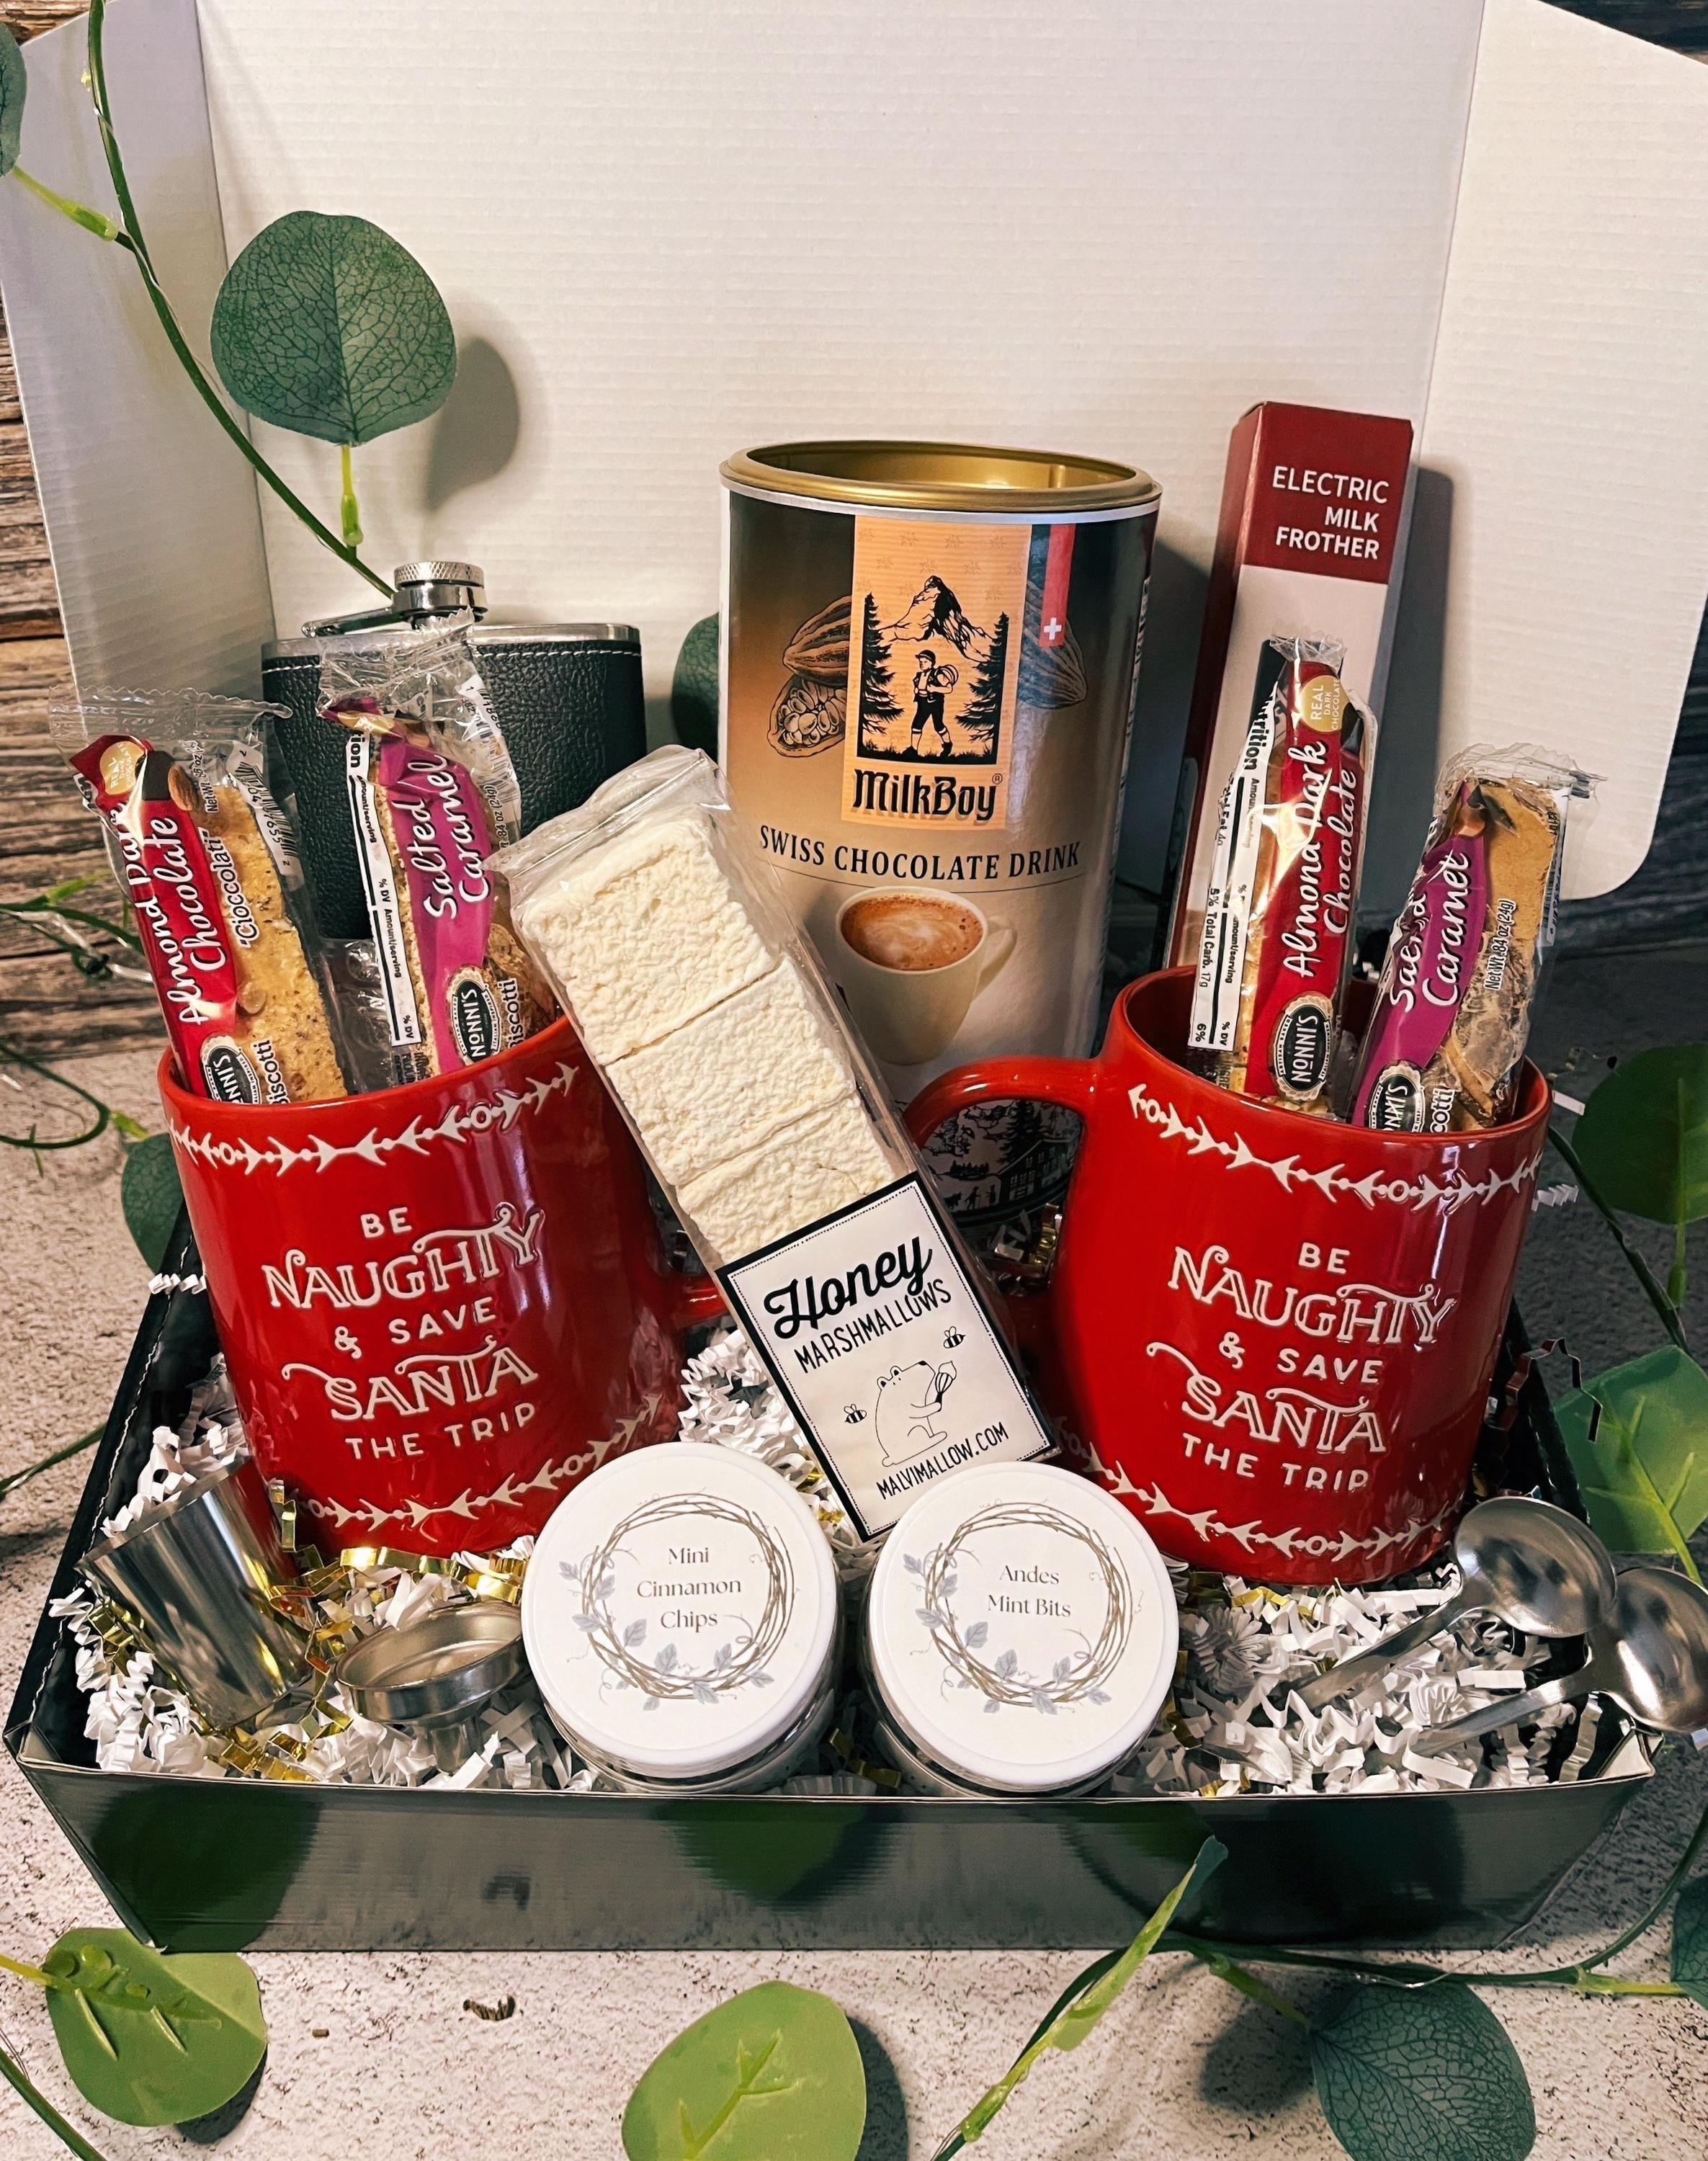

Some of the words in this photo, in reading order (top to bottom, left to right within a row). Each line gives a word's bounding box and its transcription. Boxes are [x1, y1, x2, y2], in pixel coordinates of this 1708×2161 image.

[1272, 465, 1390, 504] ELECTRIC
[1275, 526, 1380, 560] FROTHER
[1324, 506, 1380, 533] MILK
[1310, 685, 1324, 720] REAL
[1331, 677, 1341, 731] CHOCOLATE
[1287, 741, 1326, 828] Dark
[408, 754, 491, 903] Caramel
[759, 825, 826, 867] SWISS
[834, 845, 1000, 880] CHOCOLATE
[1009, 841, 1081, 878] DRINK
[1323, 768, 1356, 935] Chocolate
[391, 796, 459, 919] Salted
[144, 817, 227, 972] Chocolate
[1282, 840, 1323, 978] Almond
[1498, 899, 1516, 926] (24g)
[1205, 911, 1217, 939] Total
[1421, 852, 1470, 1007] Caramel
[1491, 939, 1507, 957] .84
[1497, 924, 1509, 937] oz
[135, 895, 210, 1026] Almond
[385, 908, 402, 978] Amount/serving
[405, 1025, 415, 1039] DV
[1199, 972, 1211, 988] 17g
[1202, 941, 1215, 969] Carb.
[1488, 956, 1505, 974] Wt
[1485, 974, 1501, 990] Net
[461, 988, 487, 1057] NONNI'S
[1195, 1023, 1207, 1042] 6%
[1220, 1032, 1229, 1046] DV
[1291, 1016, 1318, 1083] NONNI'S
[213, 1055, 243, 1104] NNI'S
[1382, 1083, 1408, 1131] NNI'S
[1430, 1088, 1455, 1133] cotti
[361, 1207, 412, 1238] BE
[261, 1206, 543, 1309] NAUGHTY
[1298, 1243, 1350, 1274] BE
[764, 1236, 933, 1339] Honey
[1168, 1245, 1457, 1344] NAUGHTY
[334, 1326, 362, 1359] &
[388, 1297, 496, 1345] SAVE
[794, 1279, 952, 1374] MARSHMALLOWS
[282, 1335, 539, 1421] SANTA
[1219, 1332, 1246, 1369] &
[1277, 1348, 1382, 1383] SAVE
[1147, 1341, 1386, 1453] SANTA
[345, 1433, 424, 1459] THE
[444, 1402, 535, 1447] TRIP
[877, 1422, 1009, 1500] MALVIMALLOW.COM
[1183, 1433, 1259, 1478] THE
[1282, 1462, 1369, 1492] TRIP
[669, 1547, 710, 1565] Mini
[999, 1565, 1060, 1585] Andes
[637, 1580, 742, 1598] Cinnamon
[988, 1594, 1030, 1615] Mint
[1036, 1598, 1071, 1618] Bits
[661, 1609, 718, 1634] Chips
